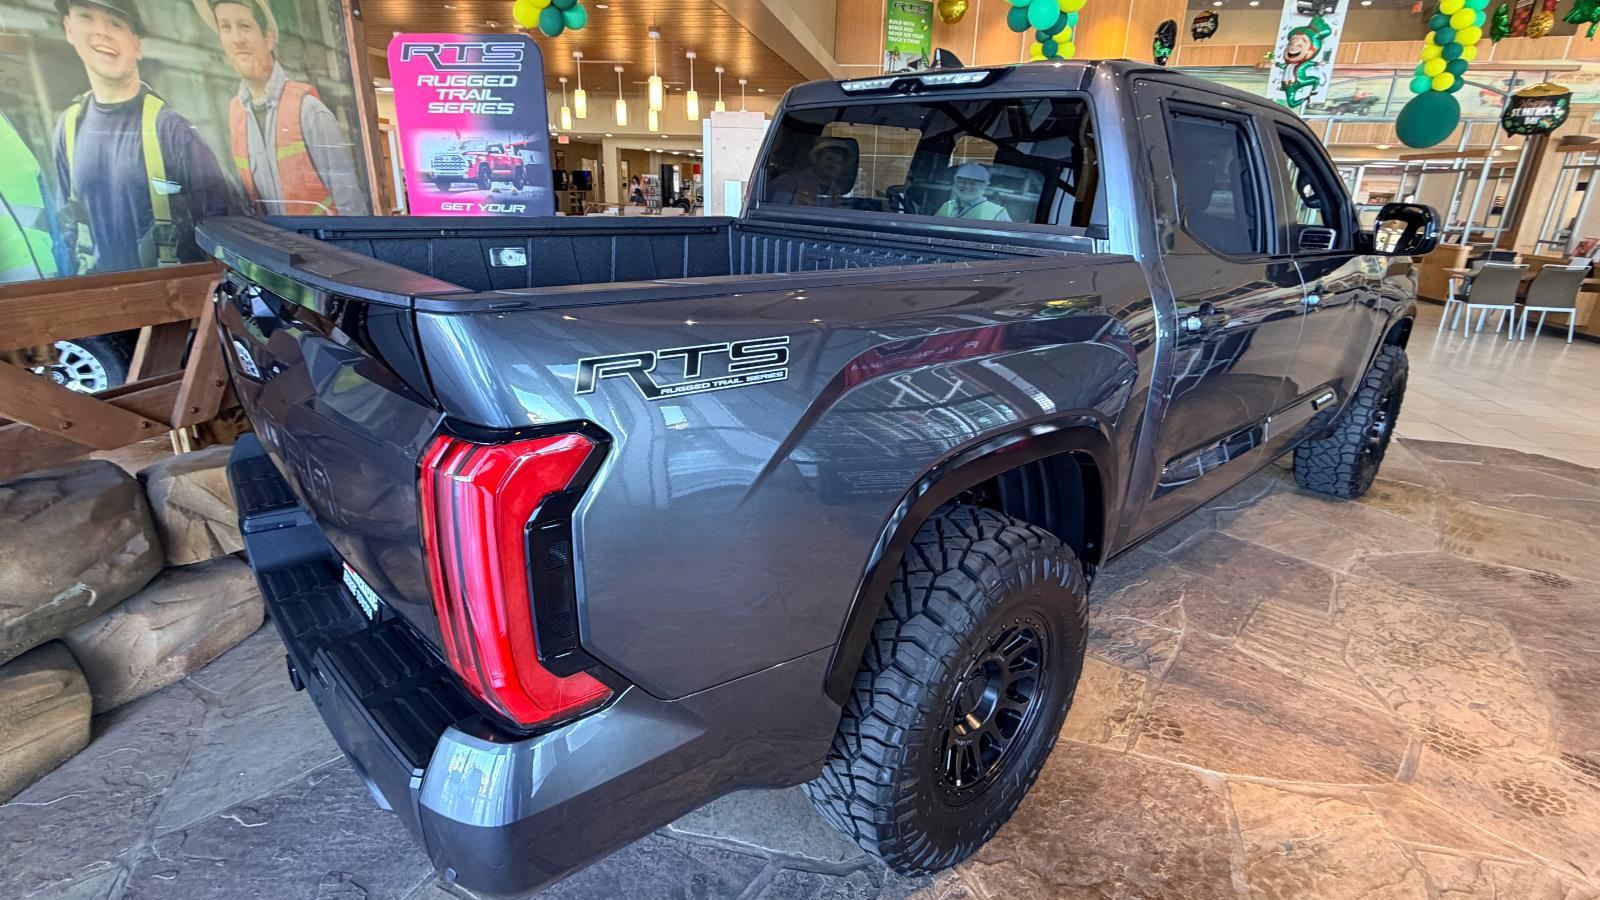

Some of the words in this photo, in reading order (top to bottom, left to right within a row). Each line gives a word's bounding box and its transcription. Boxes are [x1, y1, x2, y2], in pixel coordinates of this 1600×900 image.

[400, 42, 525, 71] RTS
[417, 75, 518, 87] RUGGED
[435, 88, 502, 101] TRAIL
[427, 102, 515, 115] SERIES
[440, 202, 475, 212] GET
[478, 203, 526, 214] YOUR
[574, 335, 790, 401] RTS
[660, 382, 711, 395] RUGGED
[712, 379, 744, 387] TRAIL
[746, 371, 784, 382] SERIES
